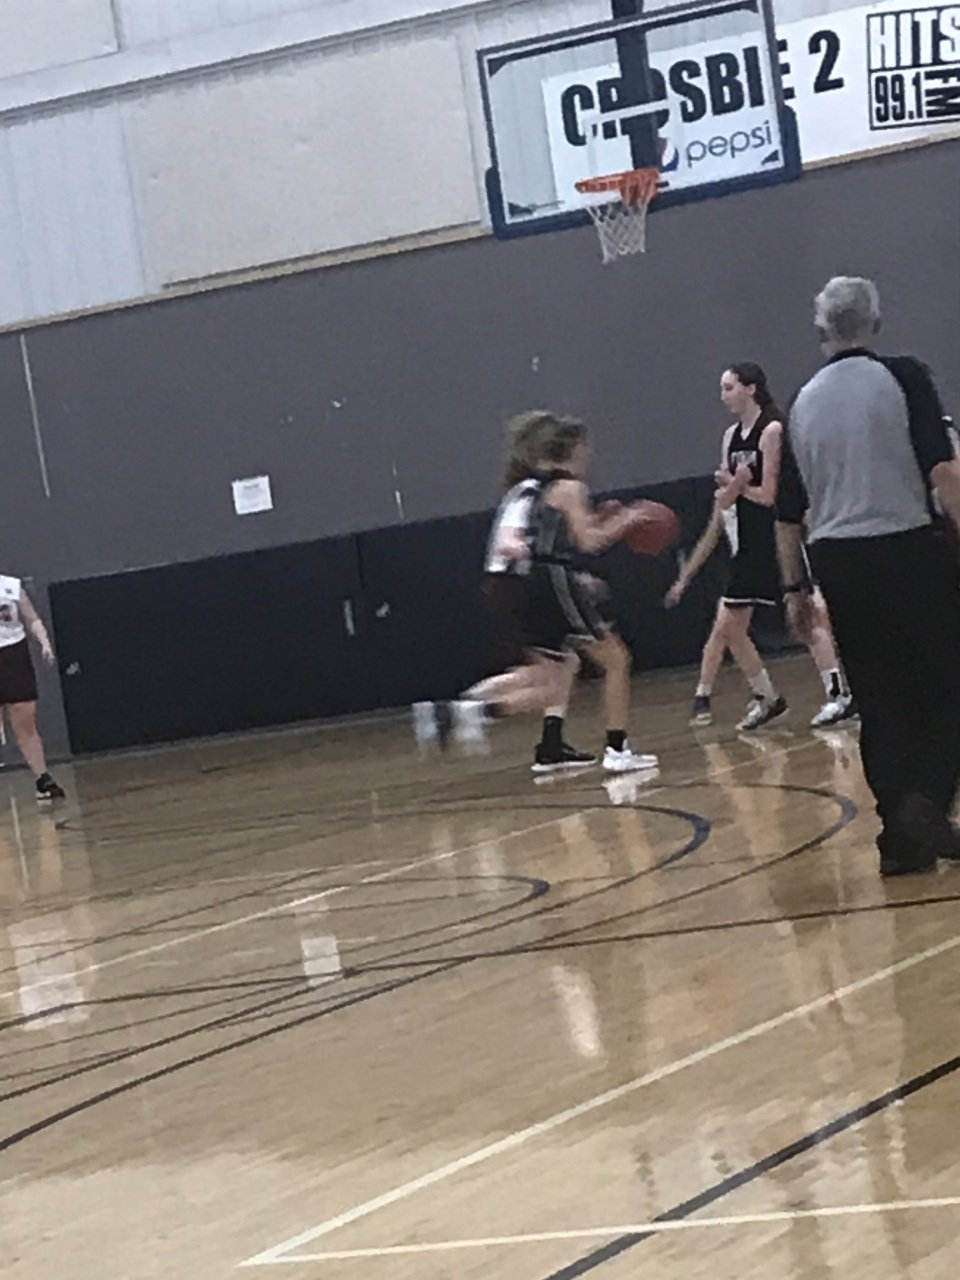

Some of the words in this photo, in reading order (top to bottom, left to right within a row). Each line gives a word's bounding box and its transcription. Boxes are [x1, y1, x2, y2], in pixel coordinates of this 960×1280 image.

[808, 29, 844, 94] 2
[869, 7, 960, 68] HITS
[874, 71, 924, 124] 99.1
[684, 119, 774, 169] pepsi
